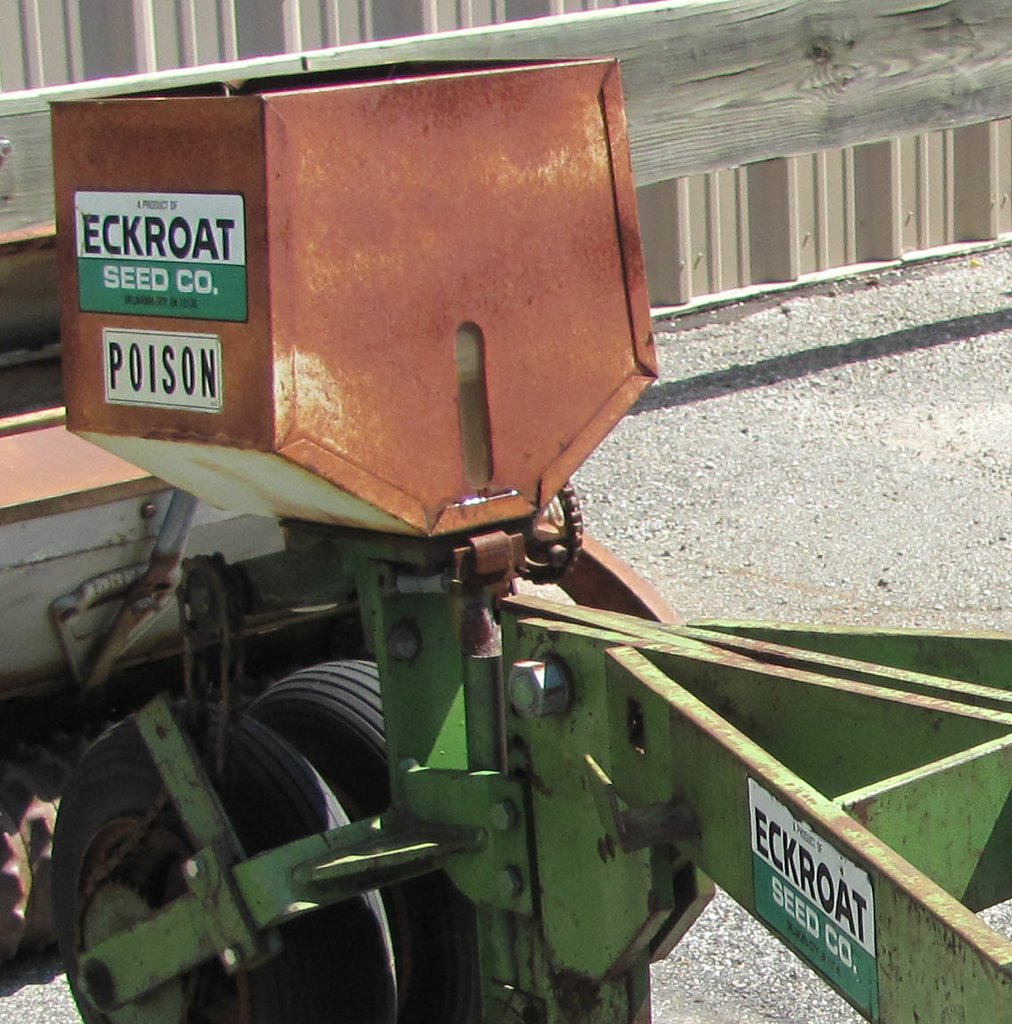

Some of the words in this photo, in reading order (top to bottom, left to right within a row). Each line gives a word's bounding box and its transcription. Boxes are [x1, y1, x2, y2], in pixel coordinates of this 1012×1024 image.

[83, 213, 235, 260] ECKROAT
[103, 265, 169, 291] SEED
[176, 269, 218, 295] CO.
[109, 341, 216, 398] POISON
[755, 807, 867, 943] ECKROAT
[772, 875, 819, 939] SEED
[825, 923, 857, 974] CO.
